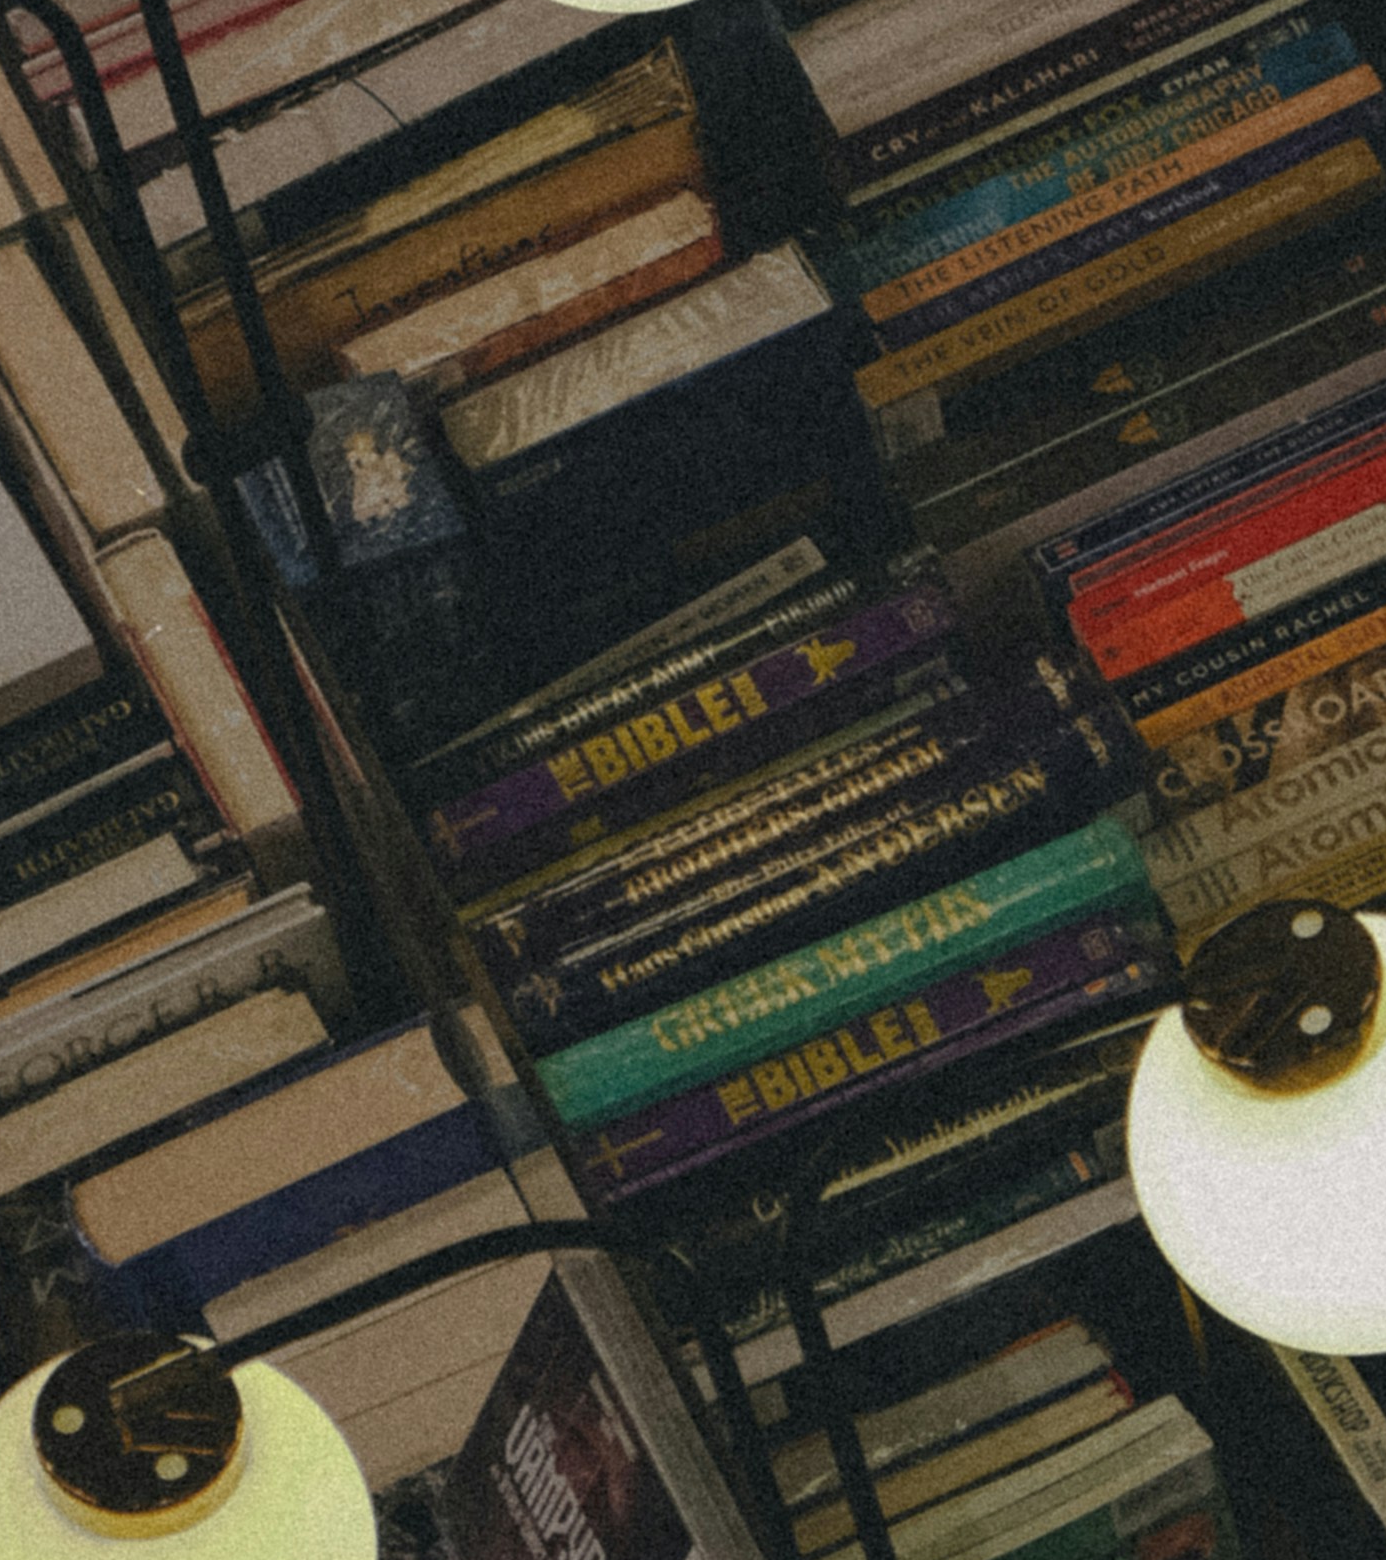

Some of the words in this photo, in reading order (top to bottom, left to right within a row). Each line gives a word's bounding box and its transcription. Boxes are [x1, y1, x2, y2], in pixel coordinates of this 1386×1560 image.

[867, 125, 924, 166] CRY
[965, 45, 1105, 123] KALAHARI
[1006, 156, 1058, 194] THE
[1059, 61, 1268, 170] AUTOBIOGRAPHY
[1063, 166, 1099, 198] OF
[1102, 134, 1169, 180] JUDY
[1169, 81, 1284, 150] CHICAGO
[336, 214, 557, 330] Inventions
[896, 258, 956, 299] THE
[957, 190, 1107, 272] LISTENING
[1125, 155, 1186, 197] PATH
[893, 338, 953, 381] THE
[955, 304, 1030, 353] VEIN
[1035, 284, 1076, 318] OF
[1080, 242, 1171, 298] GOLD
[1131, 682, 1165, 710] MY
[1174, 635, 1268, 690] COUSIN
[1274, 587, 1373, 645] RACHEL
[547, 745, 597, 803] THE
[581, 677, 748, 789] BIBLE
[10, 785, 181, 882] GALBRAITH
[648, 955, 820, 1059] GREEK
[815, 878, 999, 990] MYTHS
[717, 1075, 763, 1126] THE
[752, 1005, 917, 1111] BIBLE
